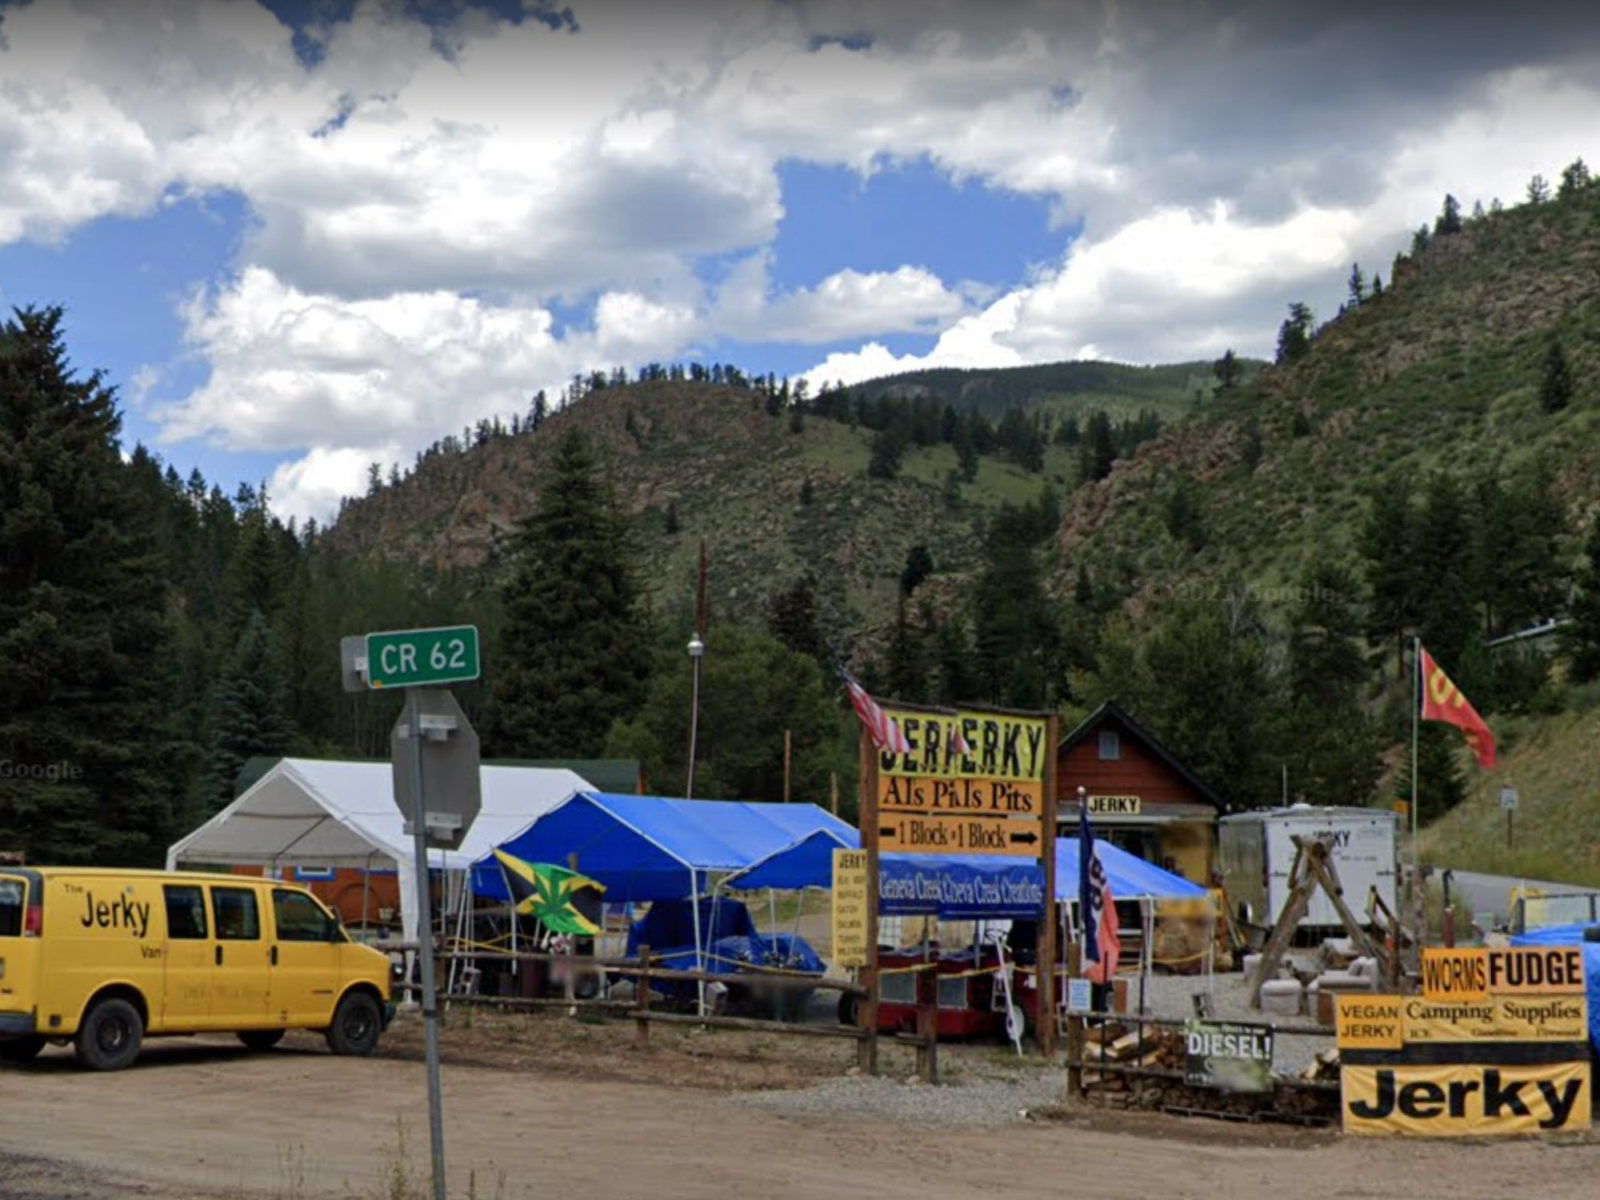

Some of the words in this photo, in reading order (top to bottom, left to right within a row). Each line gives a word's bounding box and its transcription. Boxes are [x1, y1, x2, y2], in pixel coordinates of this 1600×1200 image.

[381, 643, 418, 675] CR
[430, 639, 466, 670] 62
[990, 781, 1033, 813] Pits
[1089, 797, 1137, 812] JERKY
[910, 821, 948, 847] Block
[968, 823, 1007, 849] Block
[81, 889, 150, 939] Jerky
[141, 945, 161, 959] Van
[1426, 957, 1486, 993] WORMS
[1489, 952, 1582, 987] FUDGE
[1341, 1005, 1398, 1019] VEGAN
[1406, 1001, 1493, 1024] Camping
[1503, 1001, 1581, 1024] Supplies
[1341, 1024, 1395, 1038] JERKY
[1187, 1033, 1272, 1060] DIESEL!
[1349, 1069, 1583, 1129] Jerky
